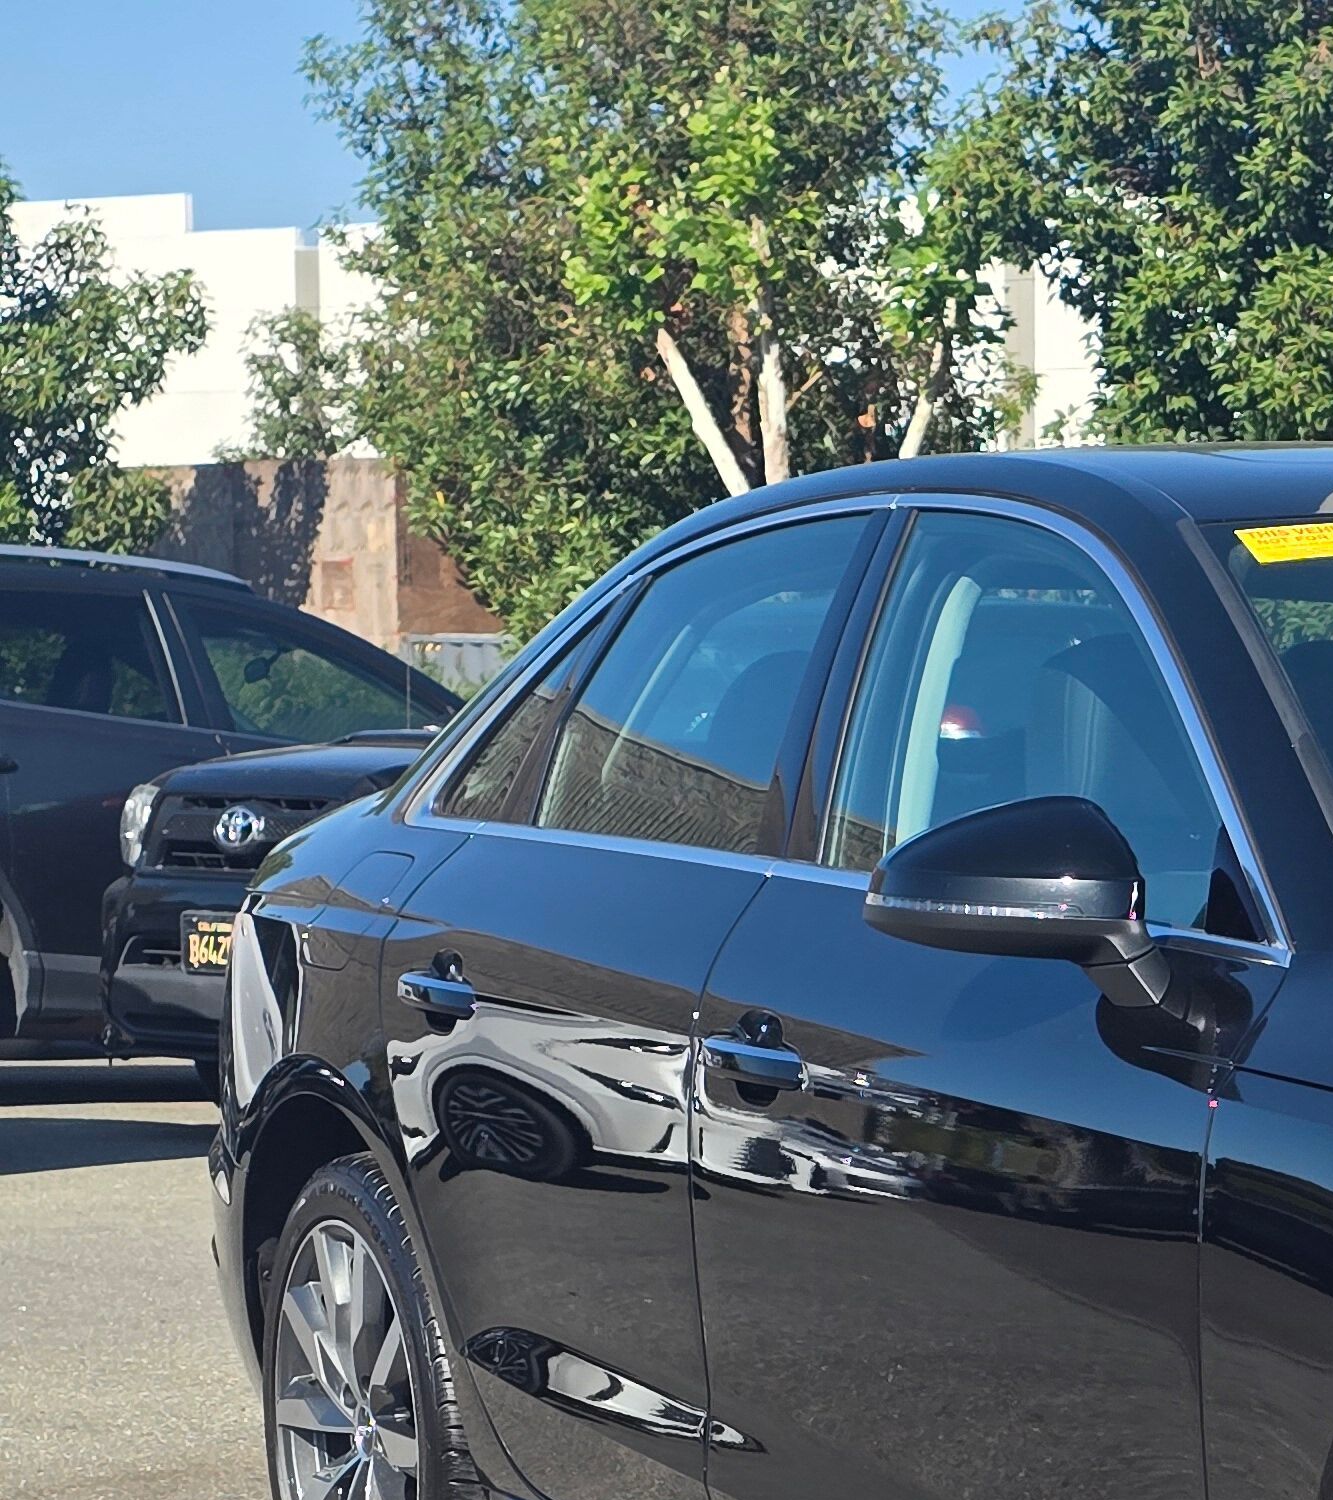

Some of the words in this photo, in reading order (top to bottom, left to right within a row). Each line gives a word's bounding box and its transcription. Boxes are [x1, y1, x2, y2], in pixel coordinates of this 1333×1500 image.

[1249, 529, 1290, 540] THIS
[1257, 537, 1289, 546] NOT
[1295, 534, 1329, 543] FOR
